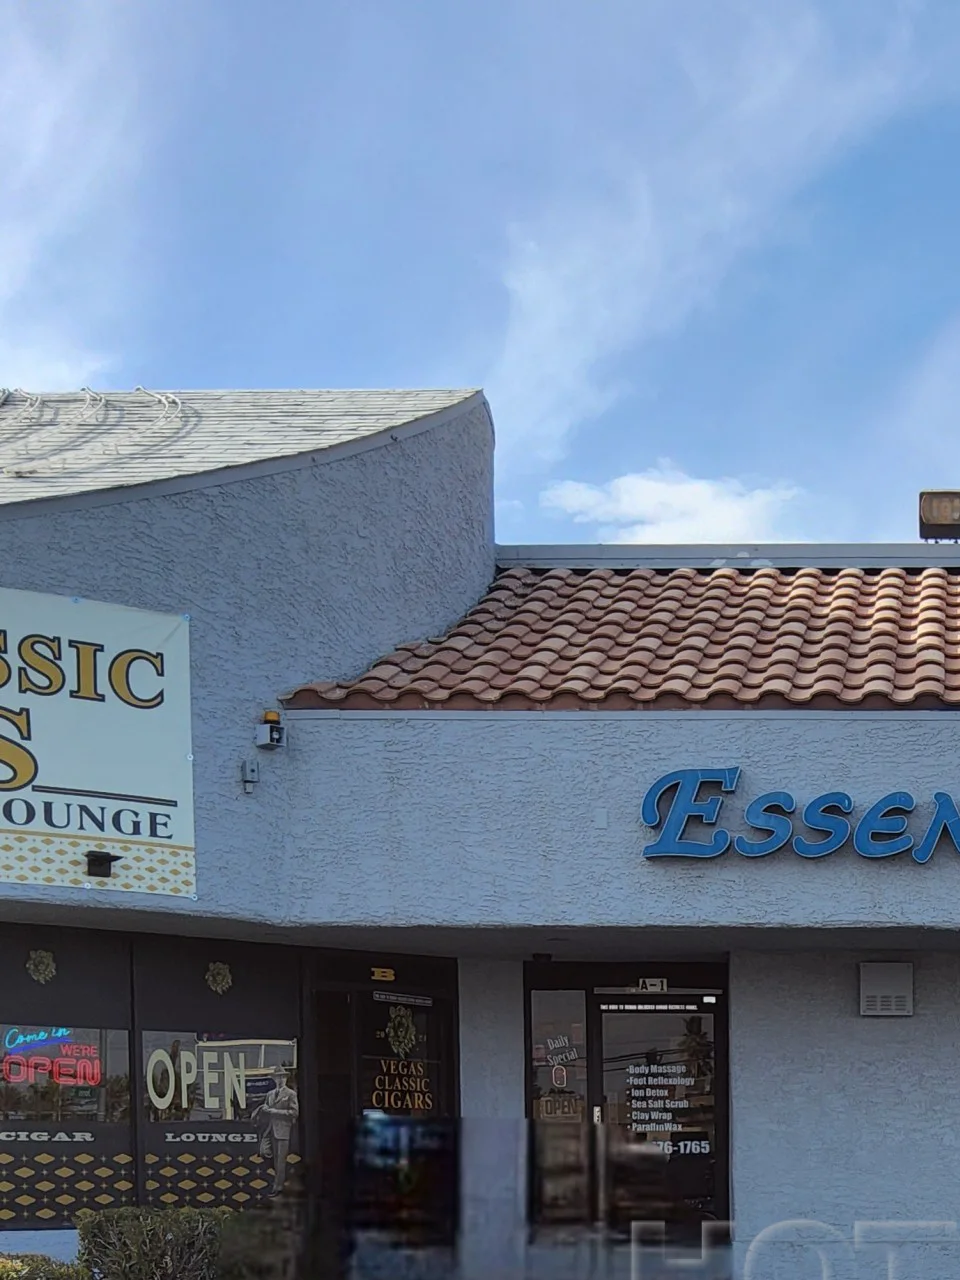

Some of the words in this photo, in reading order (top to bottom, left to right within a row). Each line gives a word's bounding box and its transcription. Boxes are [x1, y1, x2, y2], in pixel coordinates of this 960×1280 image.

[370, 967, 396, 981] B
[640, 979, 665, 992] A-1
[5, 1026, 49, 1049] Come
[51, 1026, 71, 1038] in
[547, 1034, 570, 1051] Daily
[547, 1048, 579, 1067] Special
[2, 1054, 102, 1086] OPEN
[380, 1059, 425, 1076] VEGAS
[629, 1065, 649, 1074] Body
[650, 1064, 687, 1075] Massage
[146, 1048, 247, 1110] OPEN
[375, 1075, 431, 1092] CLASSIC
[629, 1076, 647, 1085] Foot
[648, 1076, 695, 1086] Reflexology
[371, 1089, 434, 1110] CIGARS
[631, 1088, 645, 1097] Ion
[646, 1088, 669, 1097] Detox
[544, 1098, 578, 1115] OPEN
[631, 1099, 647, 1109] Sea
[648, 1099, 664, 1108] Salt
[665, 1099, 690, 1108] Scrub
[631, 1111, 650, 1121] Clay
[650, 1111, 673, 1121] Wrap
[0, 1131, 95, 1142] CIGAR
[164, 1132, 258, 1143] LOUNGE
